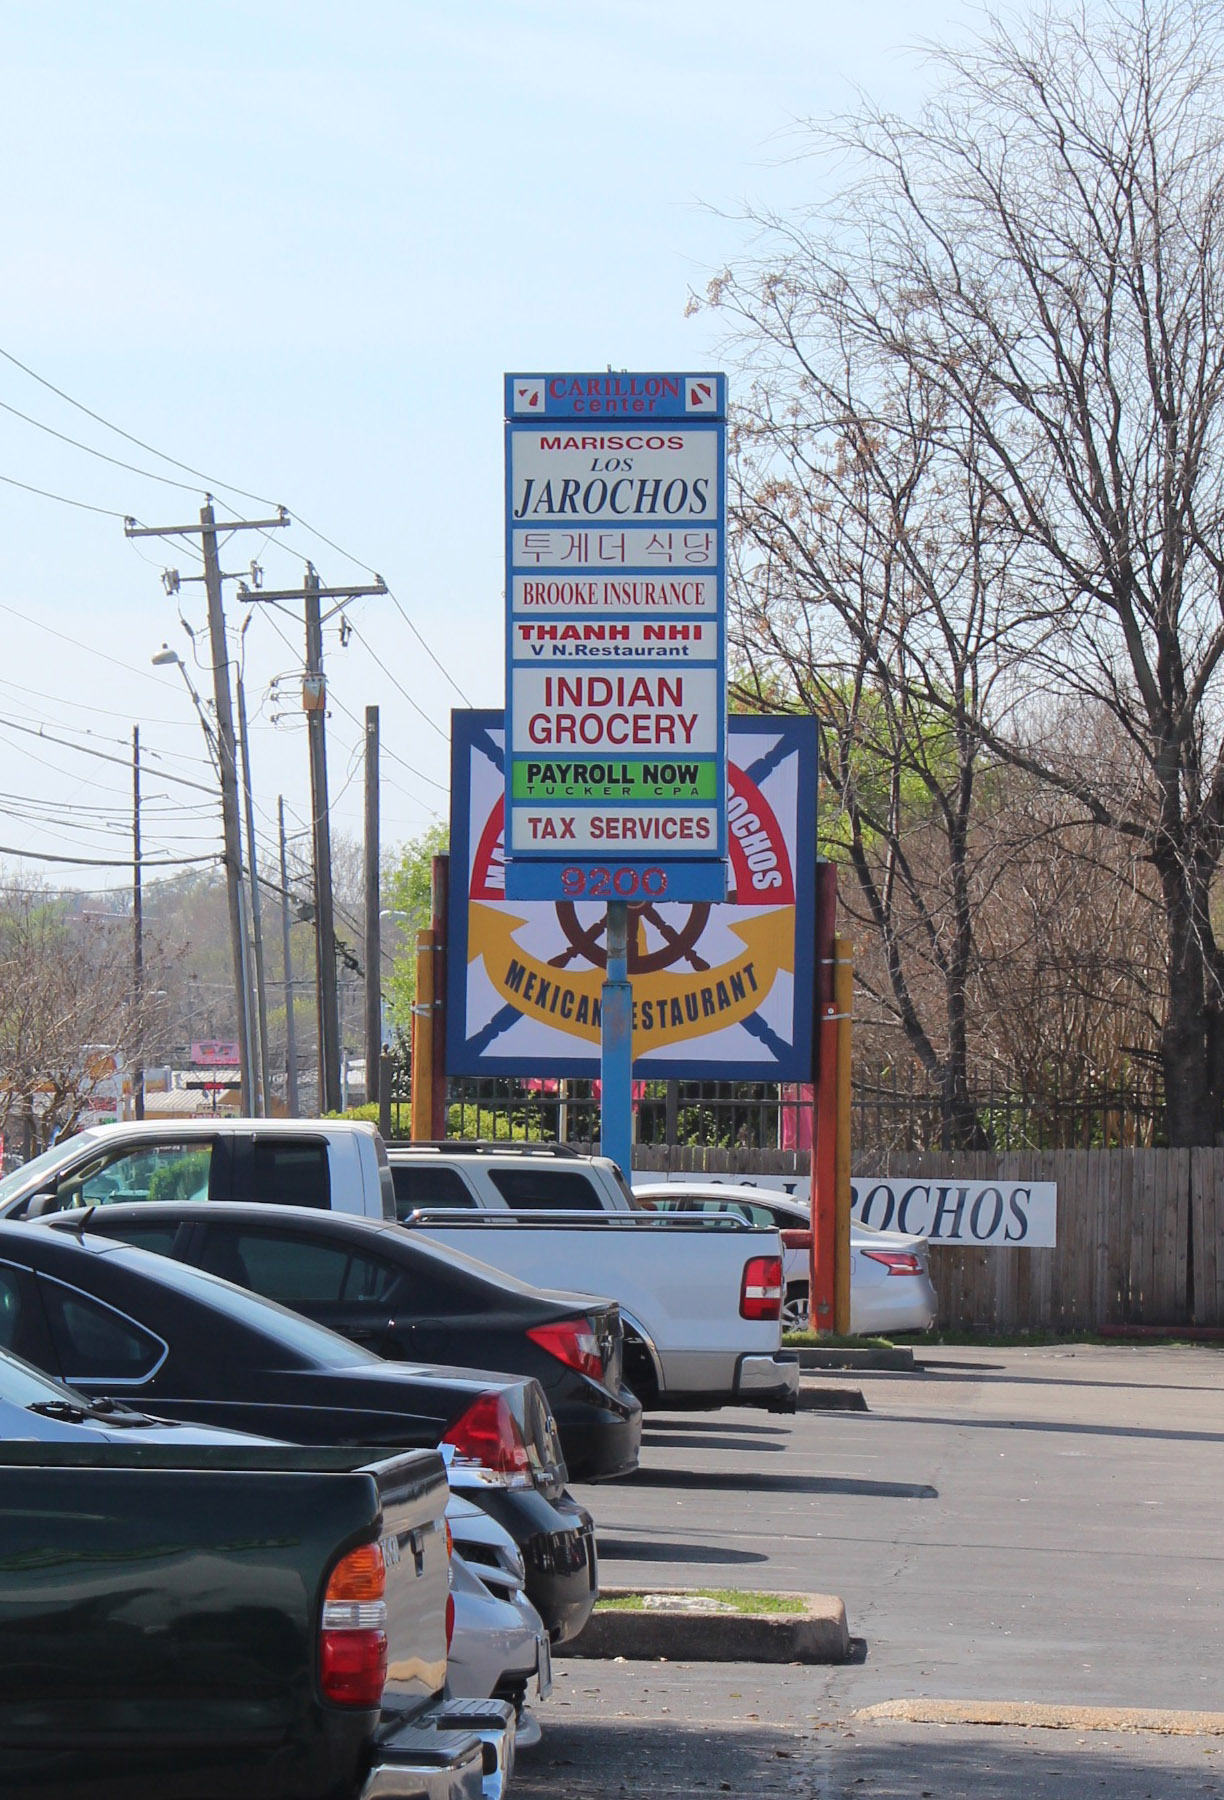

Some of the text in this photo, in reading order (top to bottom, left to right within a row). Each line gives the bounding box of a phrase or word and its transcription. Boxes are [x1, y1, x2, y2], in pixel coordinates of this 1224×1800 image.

[549, 377, 680, 398] CARILLON
[573, 398, 656, 412] center
[540, 436, 684, 450] MARISCOS
[590, 457, 634, 472] LOS
[514, 478, 709, 518] JAROCHOS
[522, 532, 713, 563] 투게더 식당
[523, 582, 705, 606] BROOKE INSURANCE
[518, 625, 702, 640] THANH NHI
[530, 644, 689, 656] V N.Restaurant
[545, 677, 683, 707] INDIAN
[528, 713, 699, 745] GROCERY
[527, 764, 699, 785] PAYROLL NOW
[527, 786, 699, 796] TUCKER CPA
[528, 816, 711, 840] TAX SERVICES
[728, 782, 783, 890] OCHOS
[561, 867, 668, 896] 9200
[631, 962, 759, 1031] ESTAURANT
[783, 1183, 1032, 1241] OCHOS
